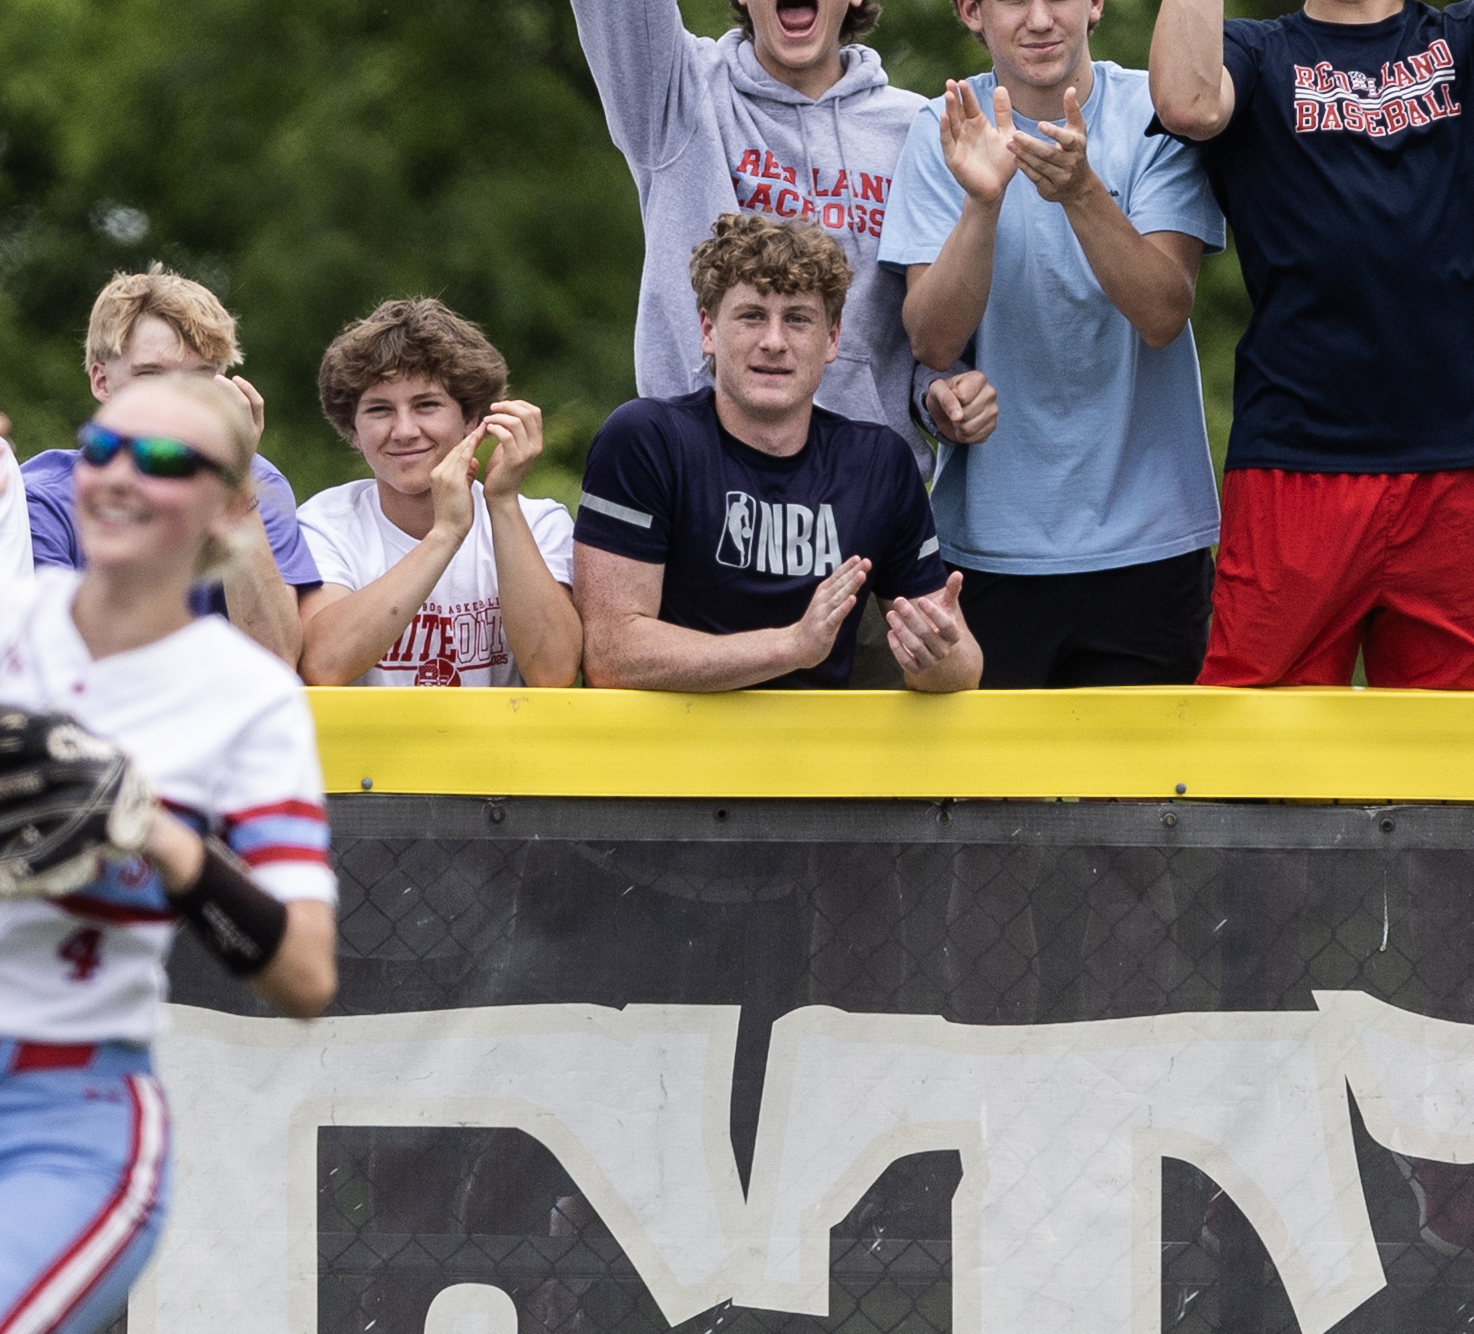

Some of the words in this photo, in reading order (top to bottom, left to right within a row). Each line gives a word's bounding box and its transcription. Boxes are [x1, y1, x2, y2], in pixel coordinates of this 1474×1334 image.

[1293, 60, 1352, 94] RED
[1379, 38, 1455, 89] LAND
[1294, 83, 1462, 137] BASEBALL
[807, 168, 893, 204] LAN
[756, 500, 843, 576] NBA
[382, 606, 504, 666] ITEOUT
[58, 926, 104, 984] 4
